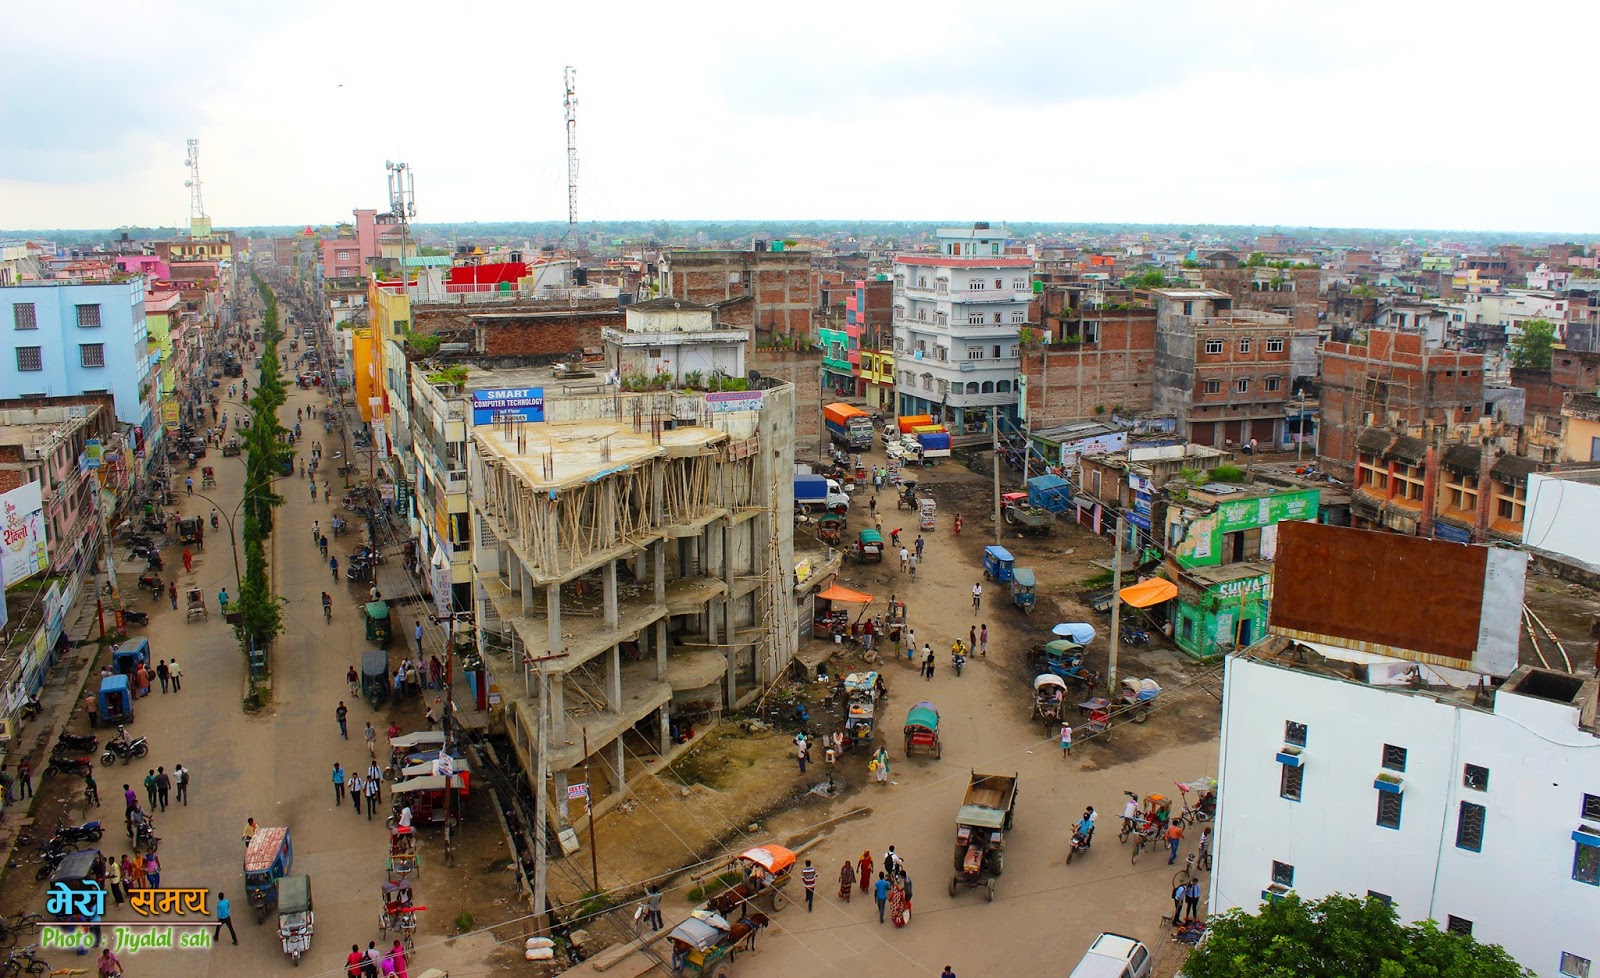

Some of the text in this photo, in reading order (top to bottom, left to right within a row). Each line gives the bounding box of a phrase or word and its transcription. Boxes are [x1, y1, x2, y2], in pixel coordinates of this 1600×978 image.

[488, 390, 529, 399] SMART
[474, 398, 543, 408] COMPUTER TECHNOLOGY
[1219, 578, 1262, 599] SHIVA
